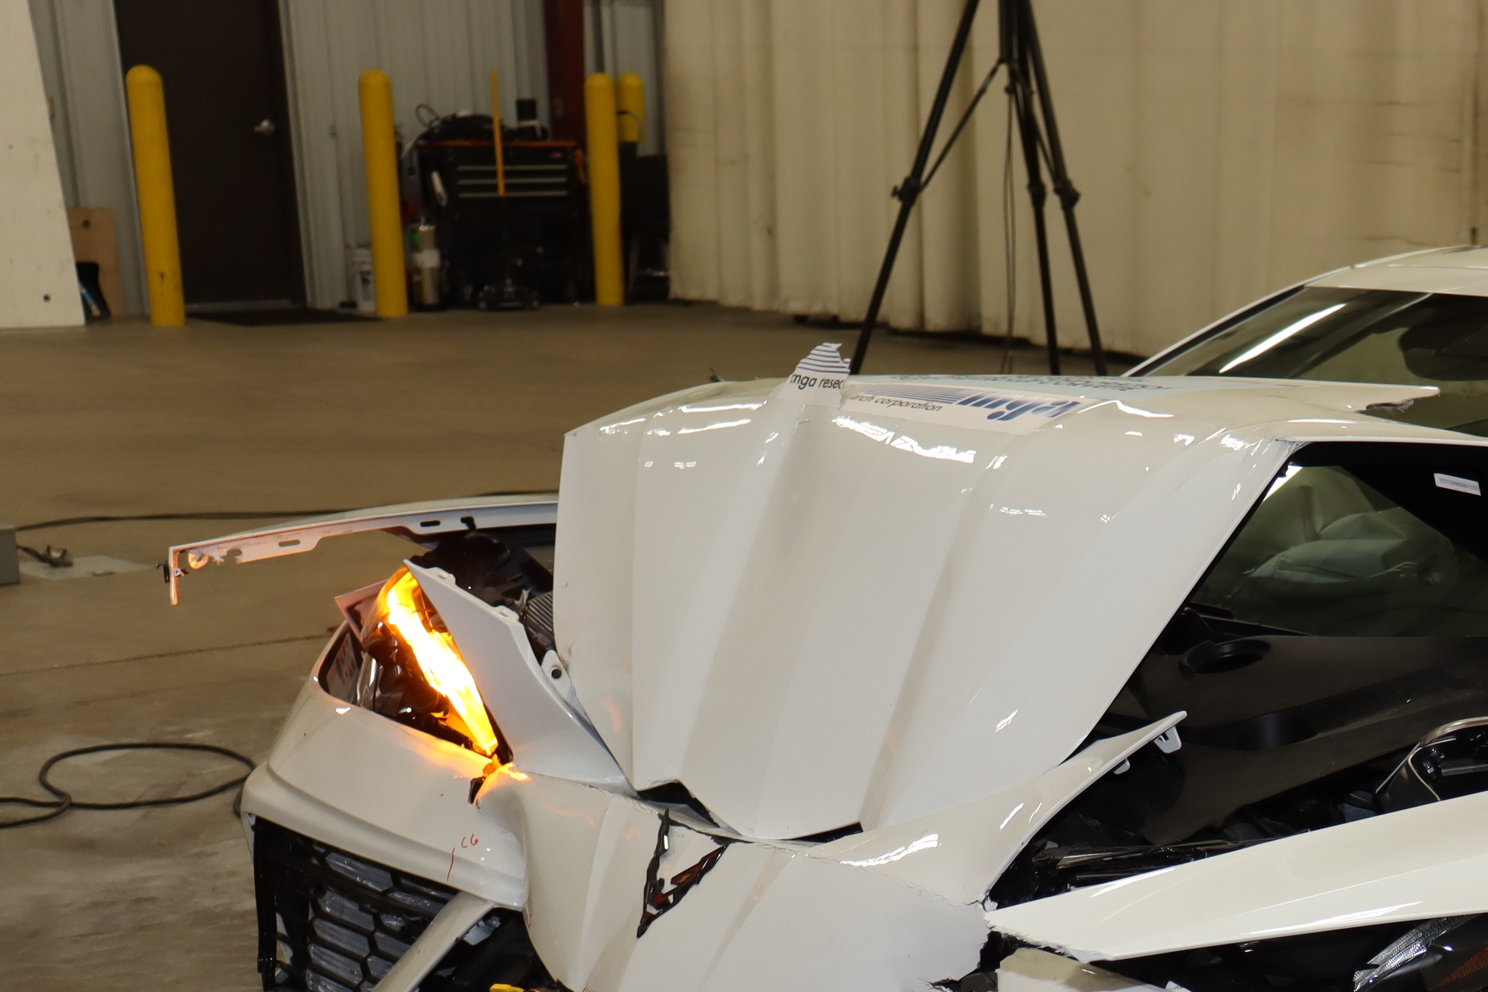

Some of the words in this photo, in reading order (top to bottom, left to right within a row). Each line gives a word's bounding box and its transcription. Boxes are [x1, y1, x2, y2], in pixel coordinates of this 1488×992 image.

[790, 373, 818, 390] mga
[875, 397, 944, 412] corporation
[957, 389, 1081, 421] mga
[461, 833, 479, 848] C6
